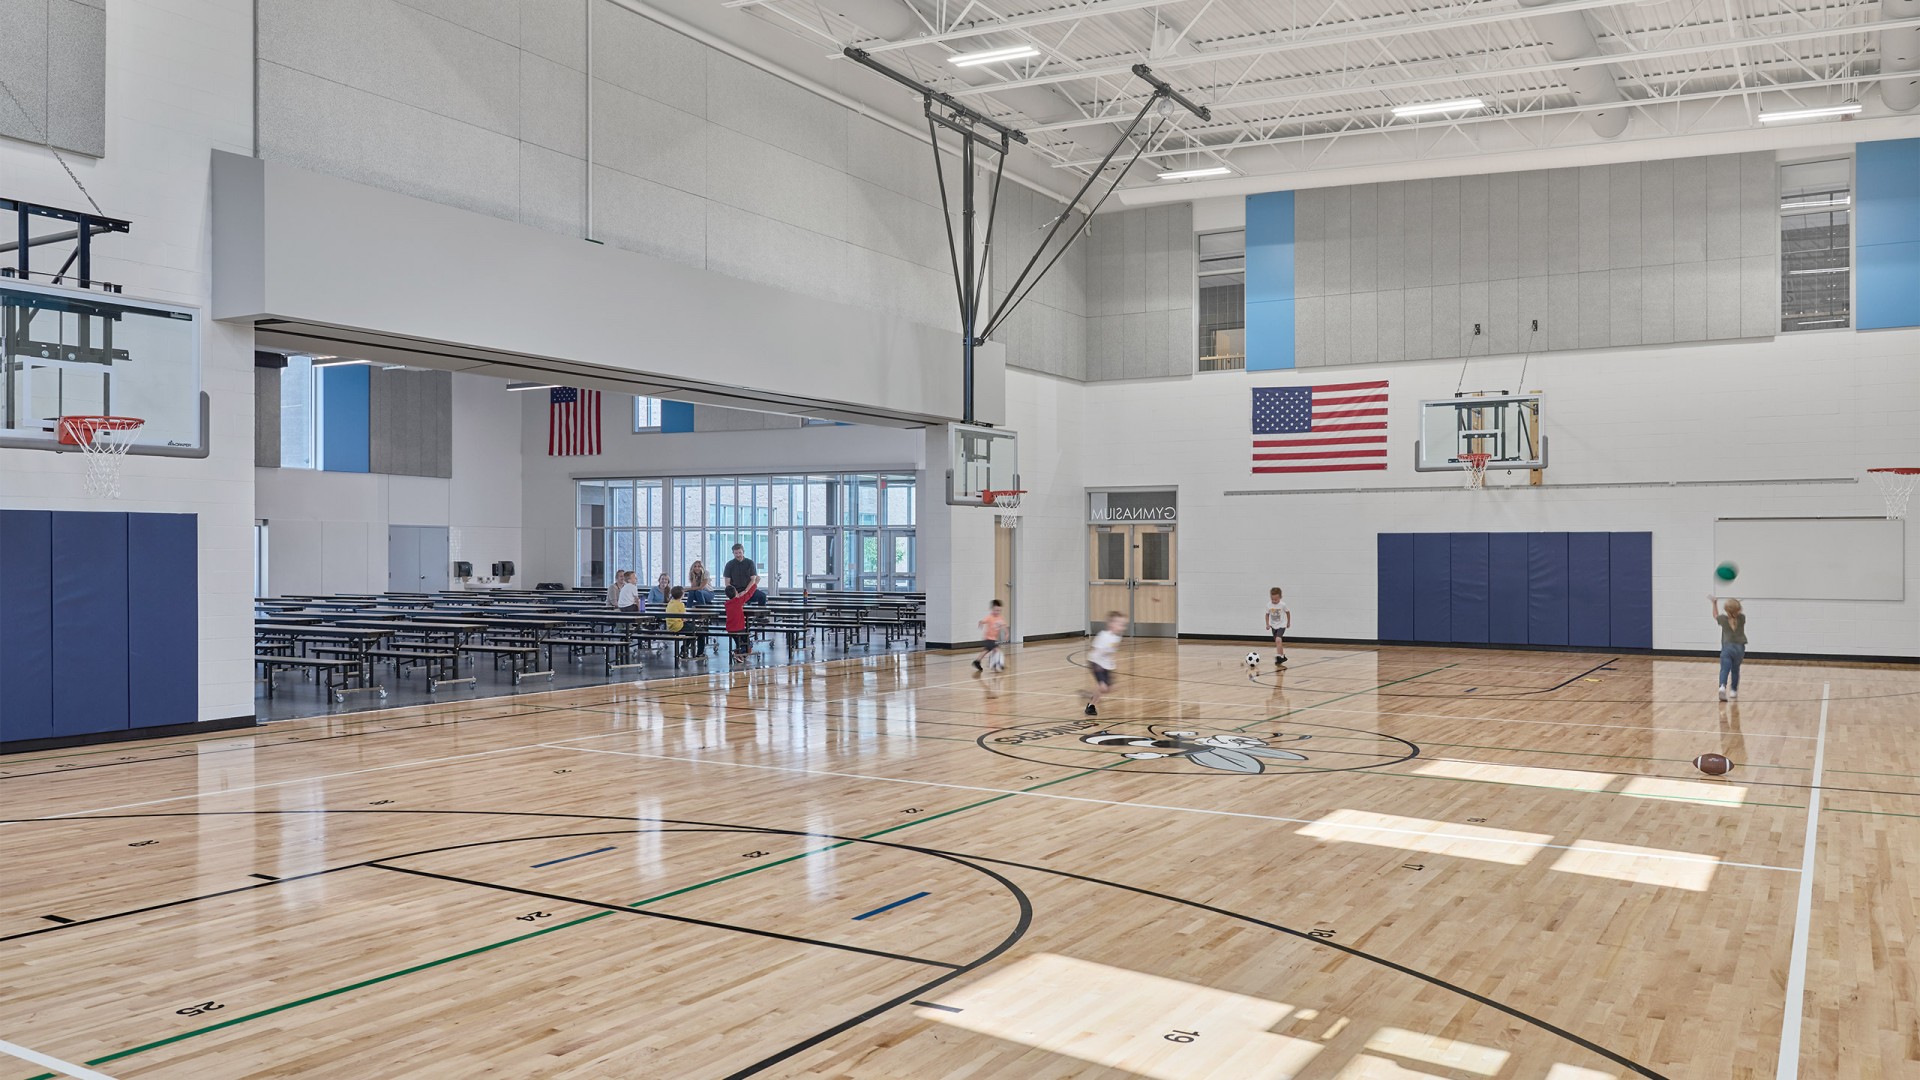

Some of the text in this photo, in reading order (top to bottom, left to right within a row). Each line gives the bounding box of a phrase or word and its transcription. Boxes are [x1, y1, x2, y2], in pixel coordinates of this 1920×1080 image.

[742, 851, 770, 859] 23
[1402, 863, 1425, 872] 17
[516, 911, 552, 922] 24
[1308, 929, 1337, 940] 18
[175, 1000, 225, 1017] 25
[1163, 1029, 1200, 1044] 19
